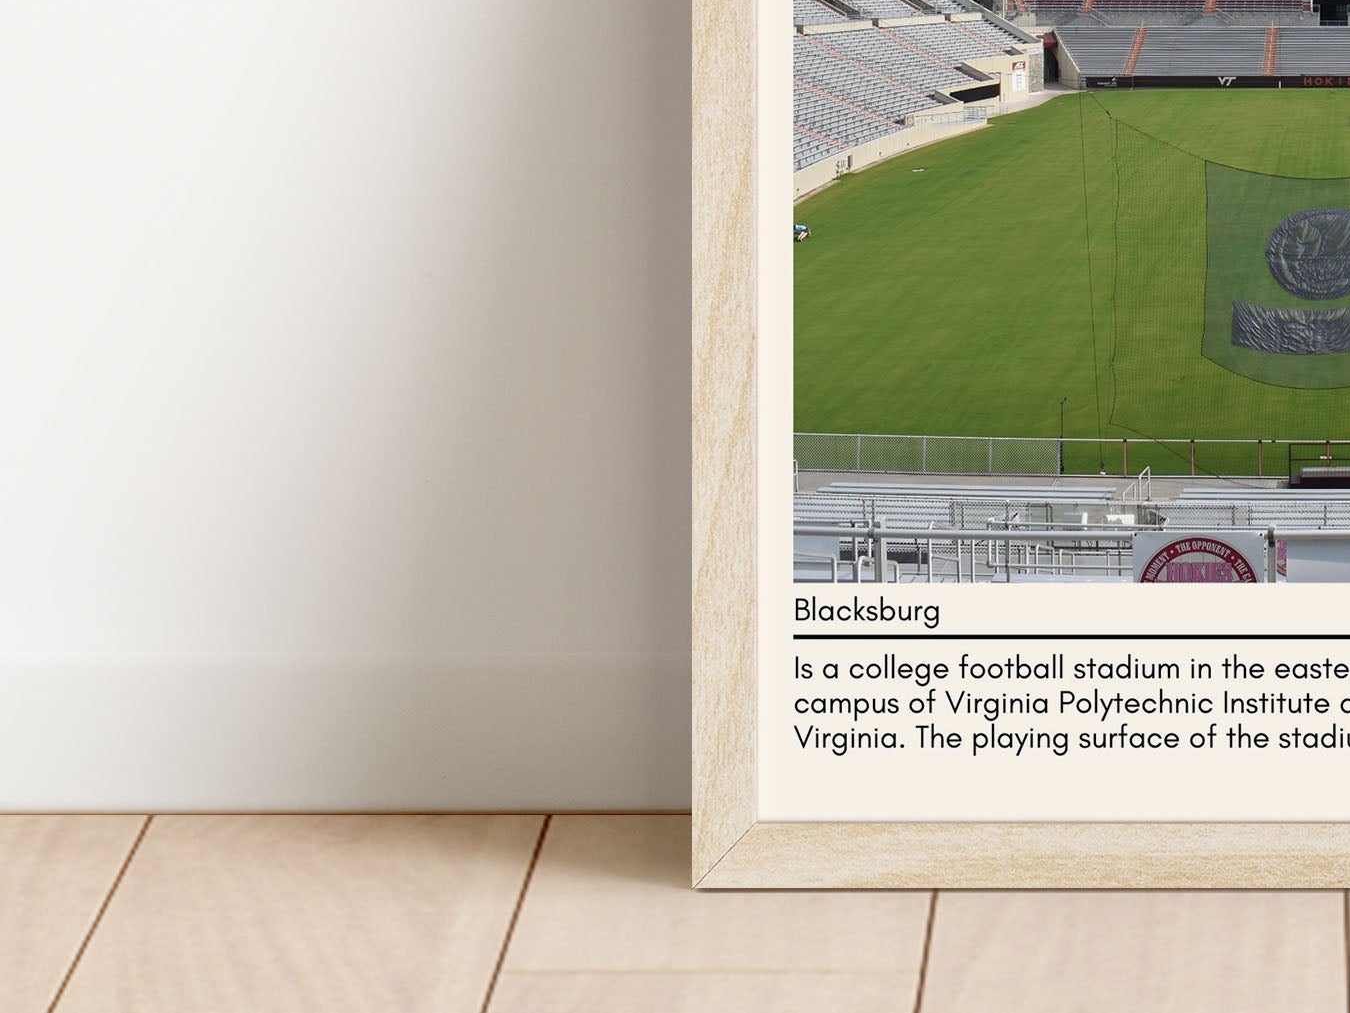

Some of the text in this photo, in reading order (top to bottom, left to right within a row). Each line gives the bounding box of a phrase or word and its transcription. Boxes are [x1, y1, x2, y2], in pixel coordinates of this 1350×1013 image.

[1175, 541, 1191, 554] THE
[1191, 540, 1231, 558] OPPONENT
[1234, 558, 1249, 575] THE
[796, 595, 940, 630] Blacksburg
[796, 656, 813, 680] Is
[822, 664, 839, 680] a
[849, 653, 949, 687] college
[958, 653, 1064, 680] football
[1073, 654, 1180, 680] stadium
[1190, 656, 1212, 679] in
[1221, 654, 1265, 679] the
[794, 697, 900, 721] campus
[908, 688, 937, 714] of
[944, 690, 1049, 721] Virginia
[1060, 688, 1213, 721] Polytechnic
[1224, 690, 1330, 714] Institute
[793, 725, 905, 757] Virginia.
[915, 723, 963, 749] The
[972, 723, 1069, 757] playing
[1078, 723, 1180, 749] surface
[1189, 723, 1217, 749] of
[1225, 723, 1270, 749] the
